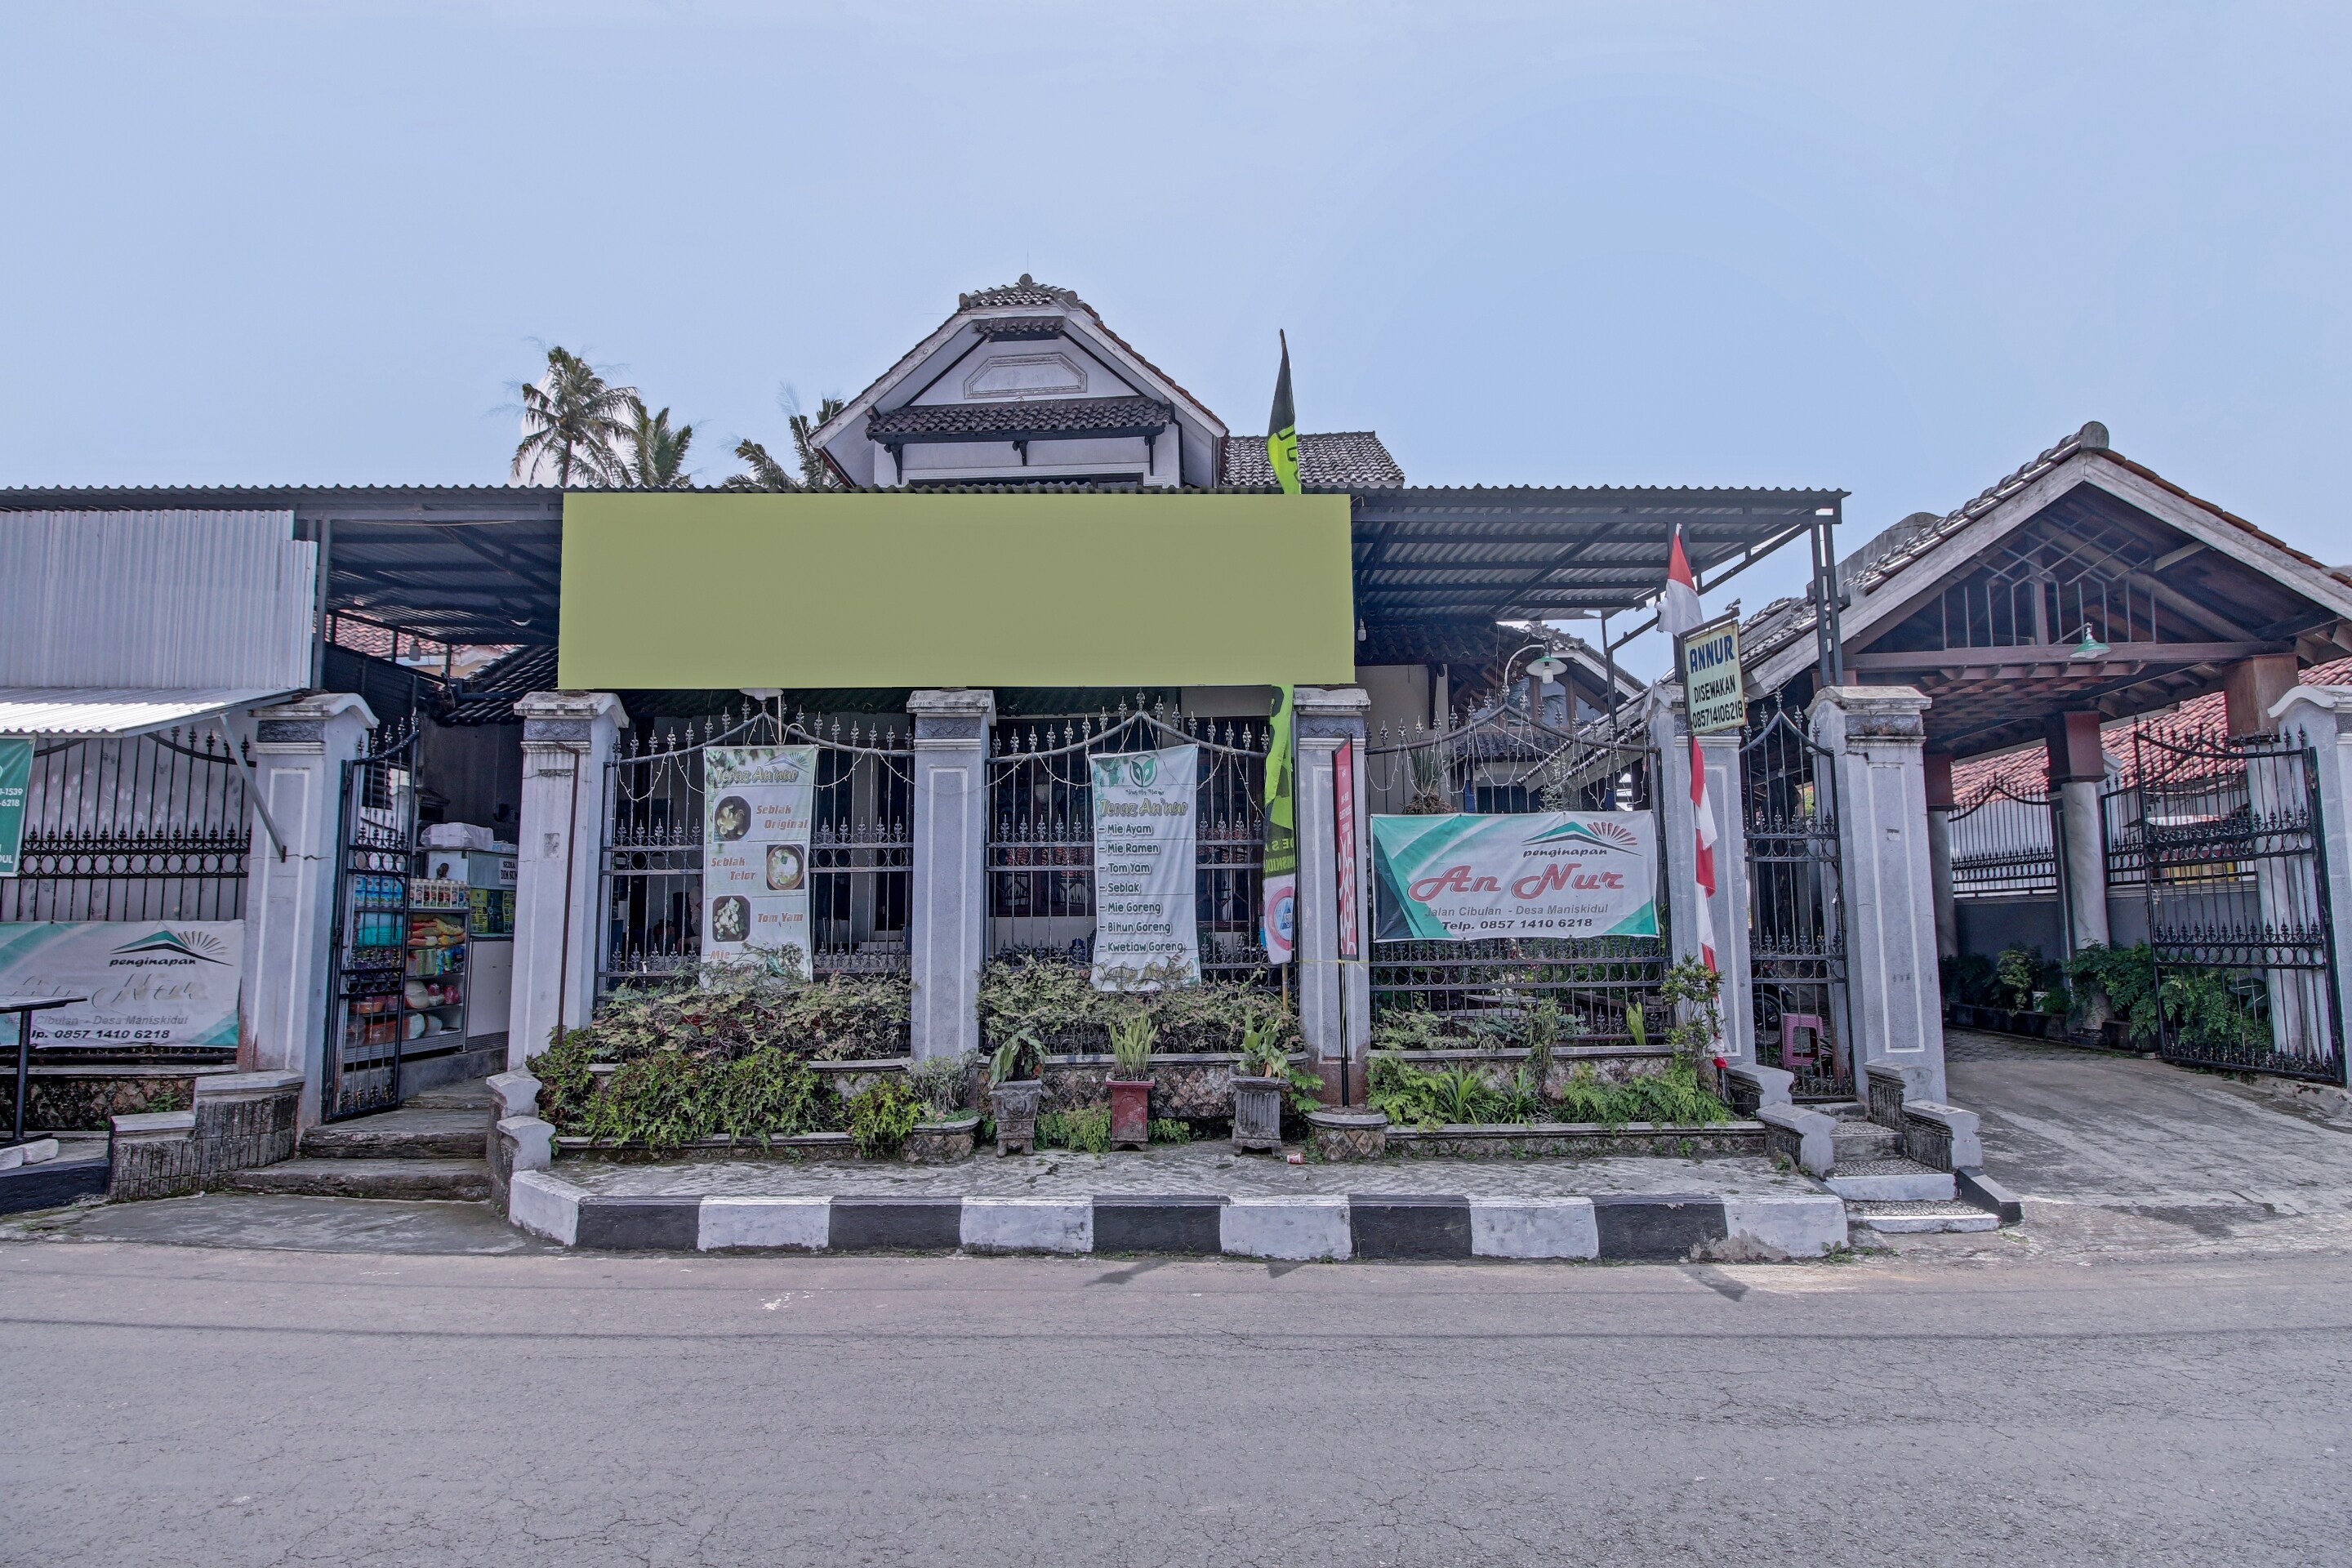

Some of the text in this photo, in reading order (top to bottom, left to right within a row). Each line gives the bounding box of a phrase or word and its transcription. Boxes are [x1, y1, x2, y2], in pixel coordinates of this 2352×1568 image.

[1689, 635, 1735, 674] ANNUR
[1694, 675, 1736, 704] DISEWAKAN
[1692, 700, 1743, 728] 085714106218
[756, 804, 792, 815] Seblak
[764, 818, 808, 830] Original
[1107, 825, 1124, 833] Mie
[1125, 824, 1152, 836] Ayam
[1107, 844, 1124, 853] Mie
[1125, 843, 1158, 853] Ramen
[1522, 848, 1607, 858] penginapan
[711, 858, 745, 867] Seblak
[1107, 863, 1127, 872] Tom
[1129, 863, 1150, 872] Yam
[730, 871, 756, 880] Telor
[1107, 882, 1140, 892] Seblak
[1408, 862, 1624, 902] An Nur
[1107, 903, 1124, 912] Mie
[1126, 902, 1160, 914] Goreng
[1424, 907, 1455, 917] Jalan
[1459, 906, 1501, 916] Cibulan
[1516, 905, 1544, 915] Desa
[1547, 904, 1608, 915] Maniskidul
[758, 913, 804, 923] Tom Yam
[1107, 922, 1134, 932] Bihun
[1136, 923, 1171, 934] Goreng
[1442, 918, 1592, 931] Telp. 0857 1410 6218
[1107, 942, 1147, 952] Kwetiaw
[1148, 942, 1184, 953] Goreng
[710, 950, 730, 960] Mie
[109, 957, 196, 967] penginapan
[93, 1016, 122, 1024] Desa
[31, 1029, 170, 1040] lp. 0857 1410 6218
